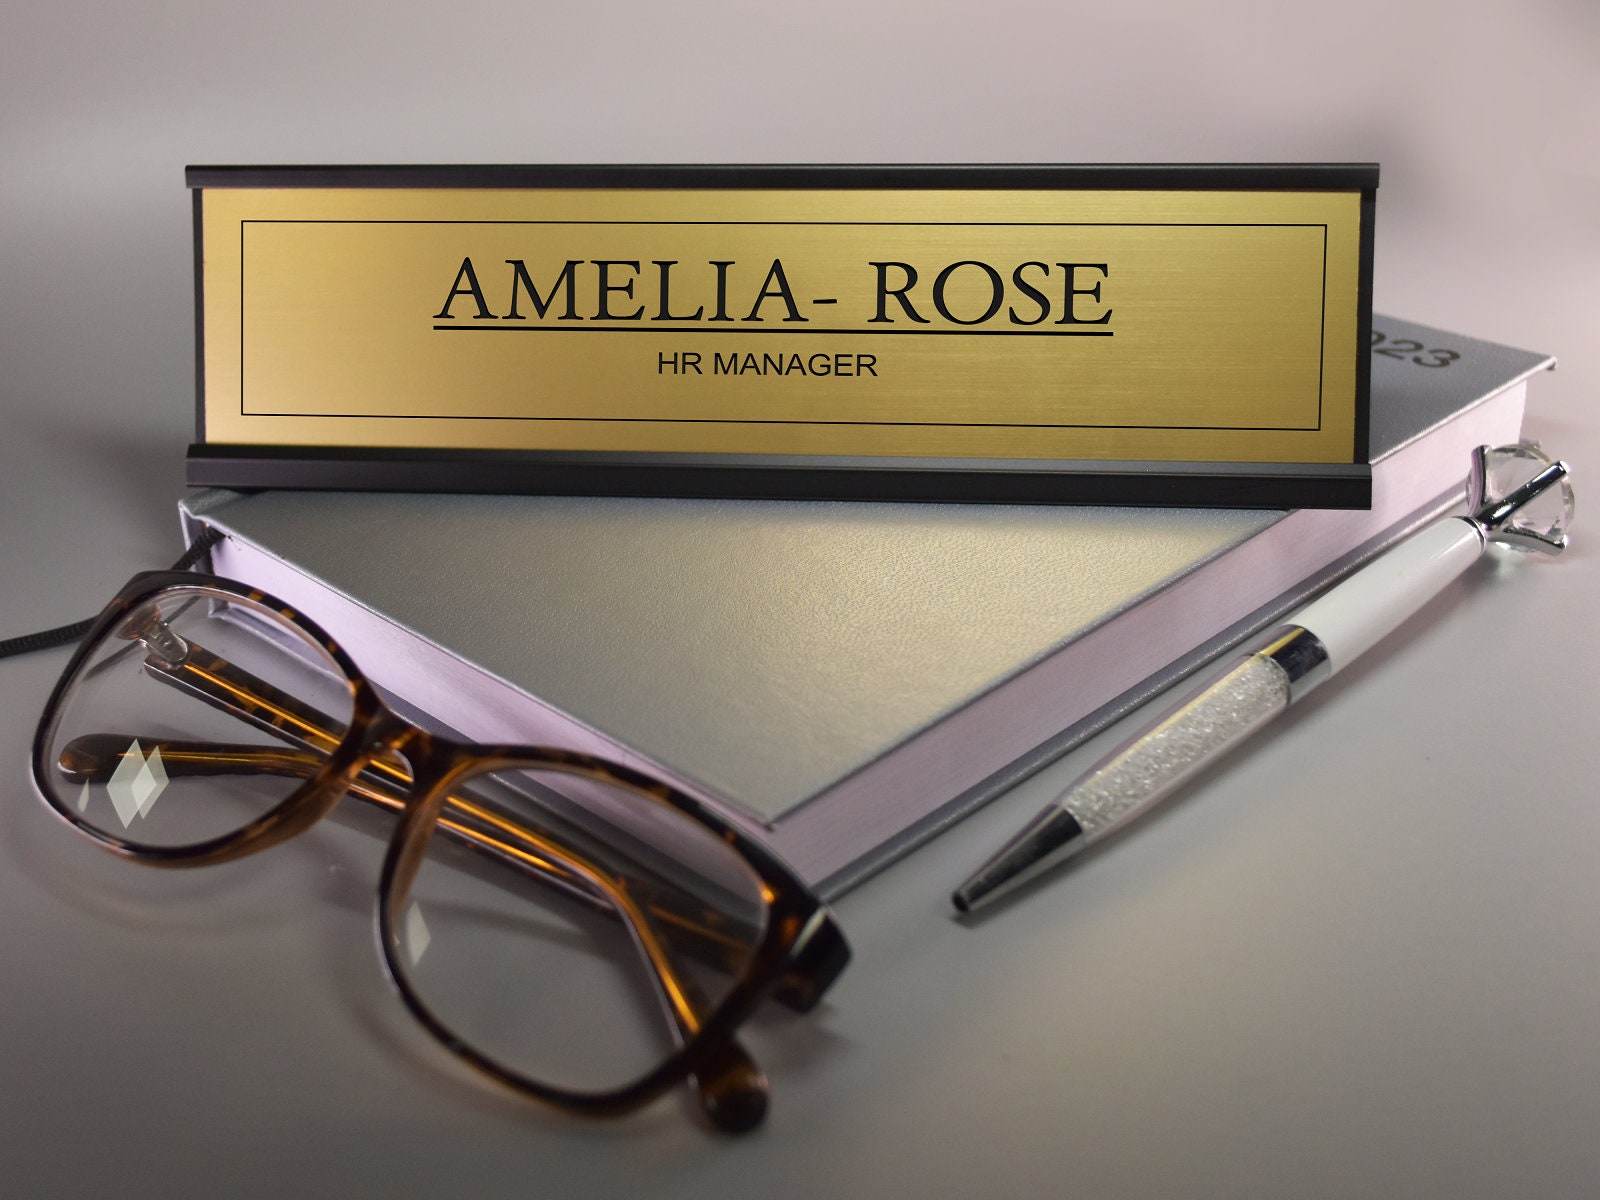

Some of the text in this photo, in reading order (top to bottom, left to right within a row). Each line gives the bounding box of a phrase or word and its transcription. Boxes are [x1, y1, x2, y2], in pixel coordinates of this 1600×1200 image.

[432, 256, 1113, 326] AMELIA- ROSE
[657, 351, 879, 378] HR MANAGER
